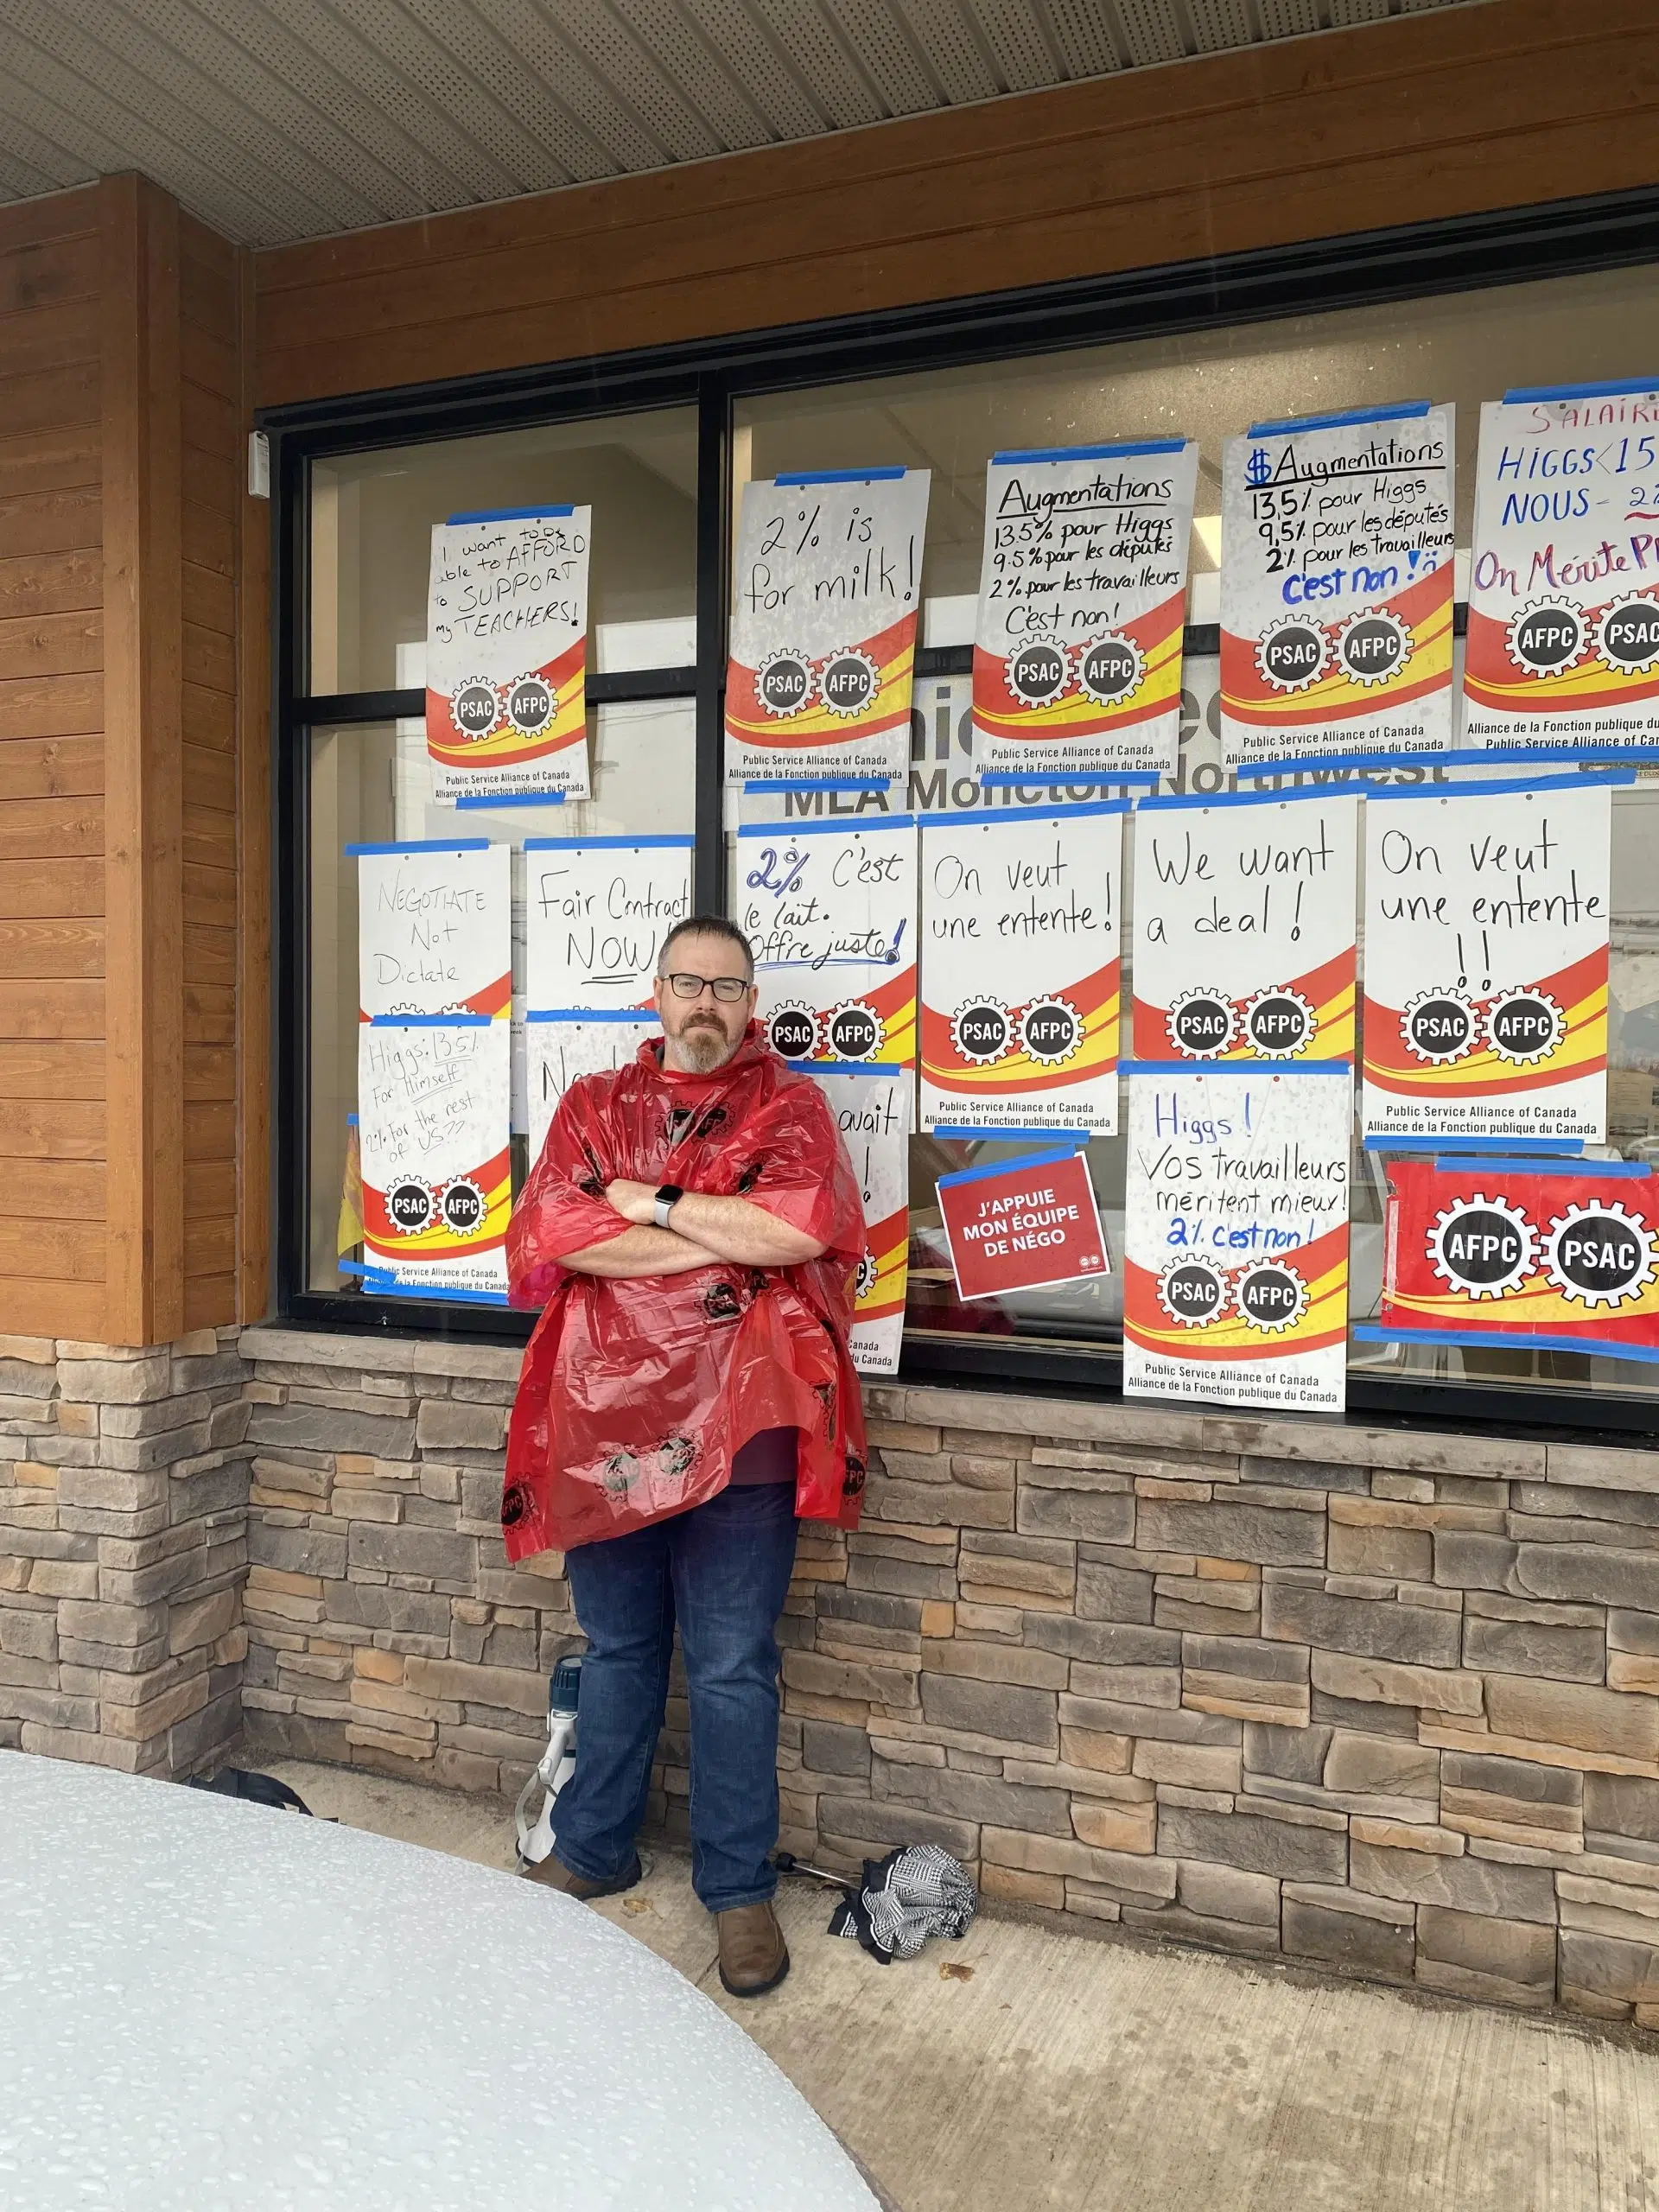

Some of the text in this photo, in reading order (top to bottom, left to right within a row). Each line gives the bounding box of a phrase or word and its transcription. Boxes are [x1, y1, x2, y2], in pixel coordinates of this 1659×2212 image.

[998, 474, 1173, 523] Augmentations
[1319, 491, 1362, 517] pour
[1374, 476, 1426, 503] Higgs
[761, 505, 872, 556] 2% is
[1061, 524, 1108, 548] pour
[1116, 511, 1173, 542] Higgs
[1313, 520, 1356, 545] pour
[1362, 511, 1382, 532] les
[1385, 503, 1449, 533] députés
[462, 537, 505, 555] want
[519, 530, 538, 539] to
[994, 548, 1042, 572] 9.5%
[1046, 550, 1079, 571] pour
[1085, 540, 1104, 560] les
[1266, 531, 1455, 573] 2% pour les travailleurs
[435, 534, 585, 586] able to AFFORD
[745, 535, 914, 613] for milk!
[1474, 550, 1519, 596] On
[435, 562, 577, 612] to SUPPORT
[989, 565, 1179, 599] 2% pour les travailleurs
[454, 601, 578, 637] TEACHERS!
[1006, 603, 1065, 634] C'est
[1270, 636, 1397, 665] PSAC AFPC
[1522, 622, 1659, 649] AFPC PSAC
[766, 674, 868, 693] PSAC AFPC
[1018, 659, 1132, 683] PSAC AFPC
[461, 696, 547, 719] PSAC AFPC
[446, 772, 569, 785] Public Service Alliance of Canada
[1154, 819, 1334, 885] We want
[1382, 818, 1559, 874] On veut
[747, 847, 903, 899] 2% C'est
[934, 840, 1067, 899] On veut
[378, 869, 486, 916] NEGOTIATE
[538, 869, 689, 919] Fair Contract
[1382, 869, 1607, 929] une entente
[745, 902, 761, 931] le
[933, 918, 981, 938] une
[1147, 917, 1168, 944] a
[747, 931, 813, 961] Offre
[373, 953, 460, 984] Dictate
[775, 1026, 873, 1042] PSAC AFPC
[963, 1022, 1071, 1040] PSAC AFPC
[1181, 1014, 1302, 1034] PSAC AFPC
[1417, 1017, 1549, 1037] PSAC AFPC
[372, 1085, 393, 1109] For
[446, 1090, 476, 1116] rest
[1368, 1121, 1597, 1135] Alliance de la Fonction publique du Canada
[1137, 1142, 1346, 1183] Vos travailleurs
[394, 1198, 478, 1215] PSAC AFPC
[977, 1189, 1056, 1217] J'APPUIE
[963, 1205, 1079, 1241] MON ÉQUIPE
[984, 1230, 1065, 1257] DE NÉGO
[1449, 1233, 1635, 1271] AFPC PSAC
[1172, 1281, 1294, 1306] PSAC AFPC
[1128, 1377, 1338, 1402] Alliance de la Fonction publique du Canada
[1146, 1363, 1319, 1387] Public Service Alliance of Canada
